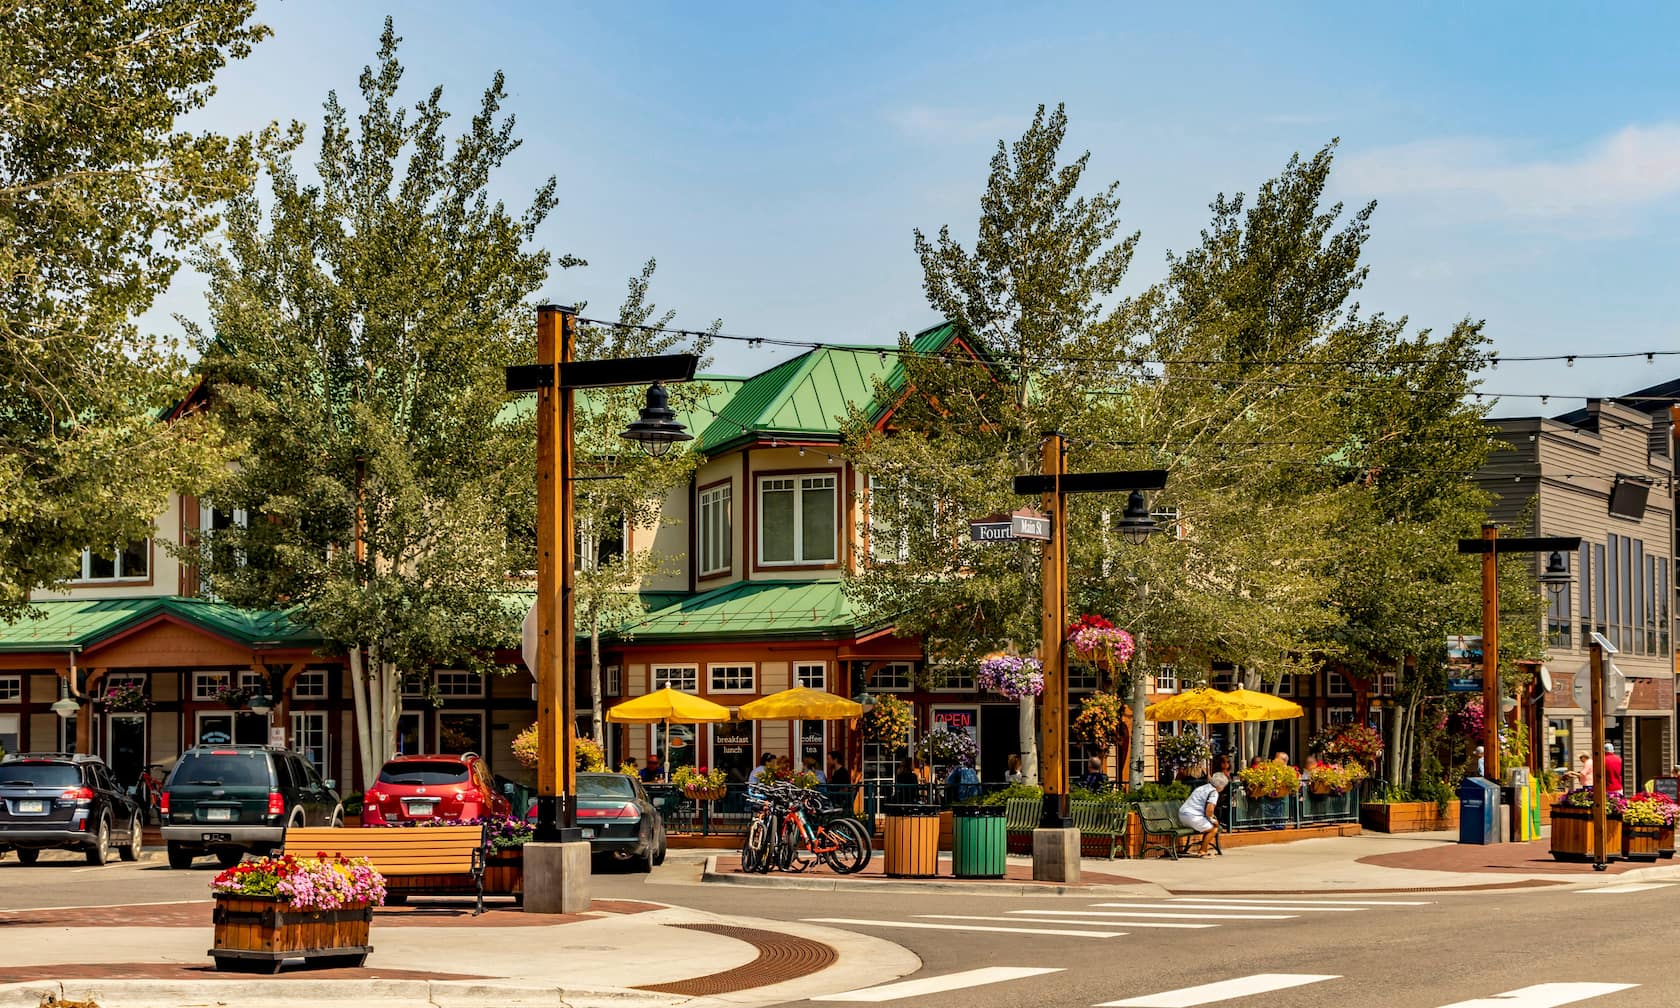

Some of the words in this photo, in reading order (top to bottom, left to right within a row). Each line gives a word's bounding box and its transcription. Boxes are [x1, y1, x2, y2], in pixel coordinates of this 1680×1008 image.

[1021, 519, 1035, 534] Main
[1036, 521, 1042, 535] St
[935, 713, 970, 727] OPEN
[716, 735, 749, 744] breakfast
[801, 734, 823, 743] coffee
[723, 745, 743, 754] lunch
